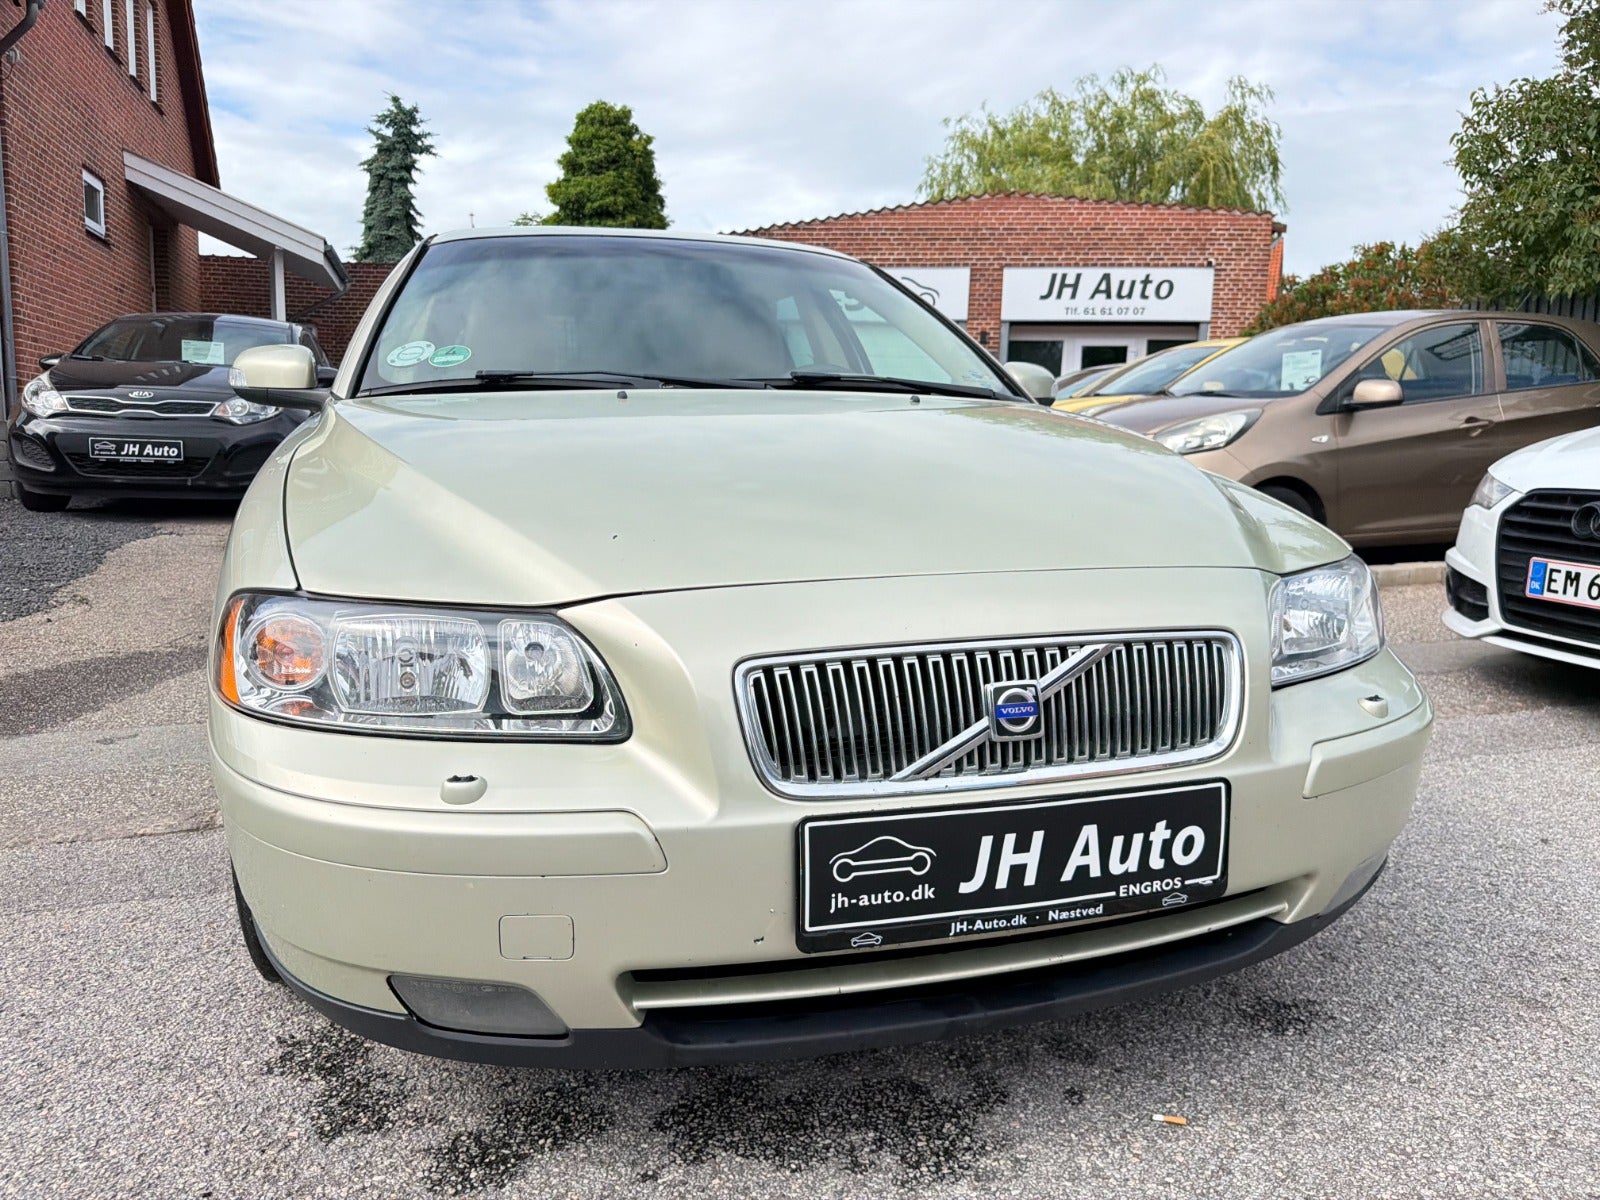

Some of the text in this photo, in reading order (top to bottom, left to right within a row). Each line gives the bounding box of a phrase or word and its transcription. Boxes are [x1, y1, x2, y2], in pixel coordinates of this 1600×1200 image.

[1039, 272, 1174, 300] JH Auto
[1083, 307, 1096, 315] 61
[1116, 307, 1129, 315] 07
[1132, 307, 1146, 315] 07
[121, 443, 139, 456] JH
[143, 444, 178, 456] Auto
[1530, 580, 1541, 591] DK
[1546, 568, 1581, 598] EM
[1001, 705, 1034, 715] VOLVO
[958, 820, 1205, 894] JH Auto
[829, 883, 935, 914] jh-auto.dk
[1119, 877, 1182, 897] ENGROS
[949, 903, 1103, 936] JH-Auto.dk Næstved
